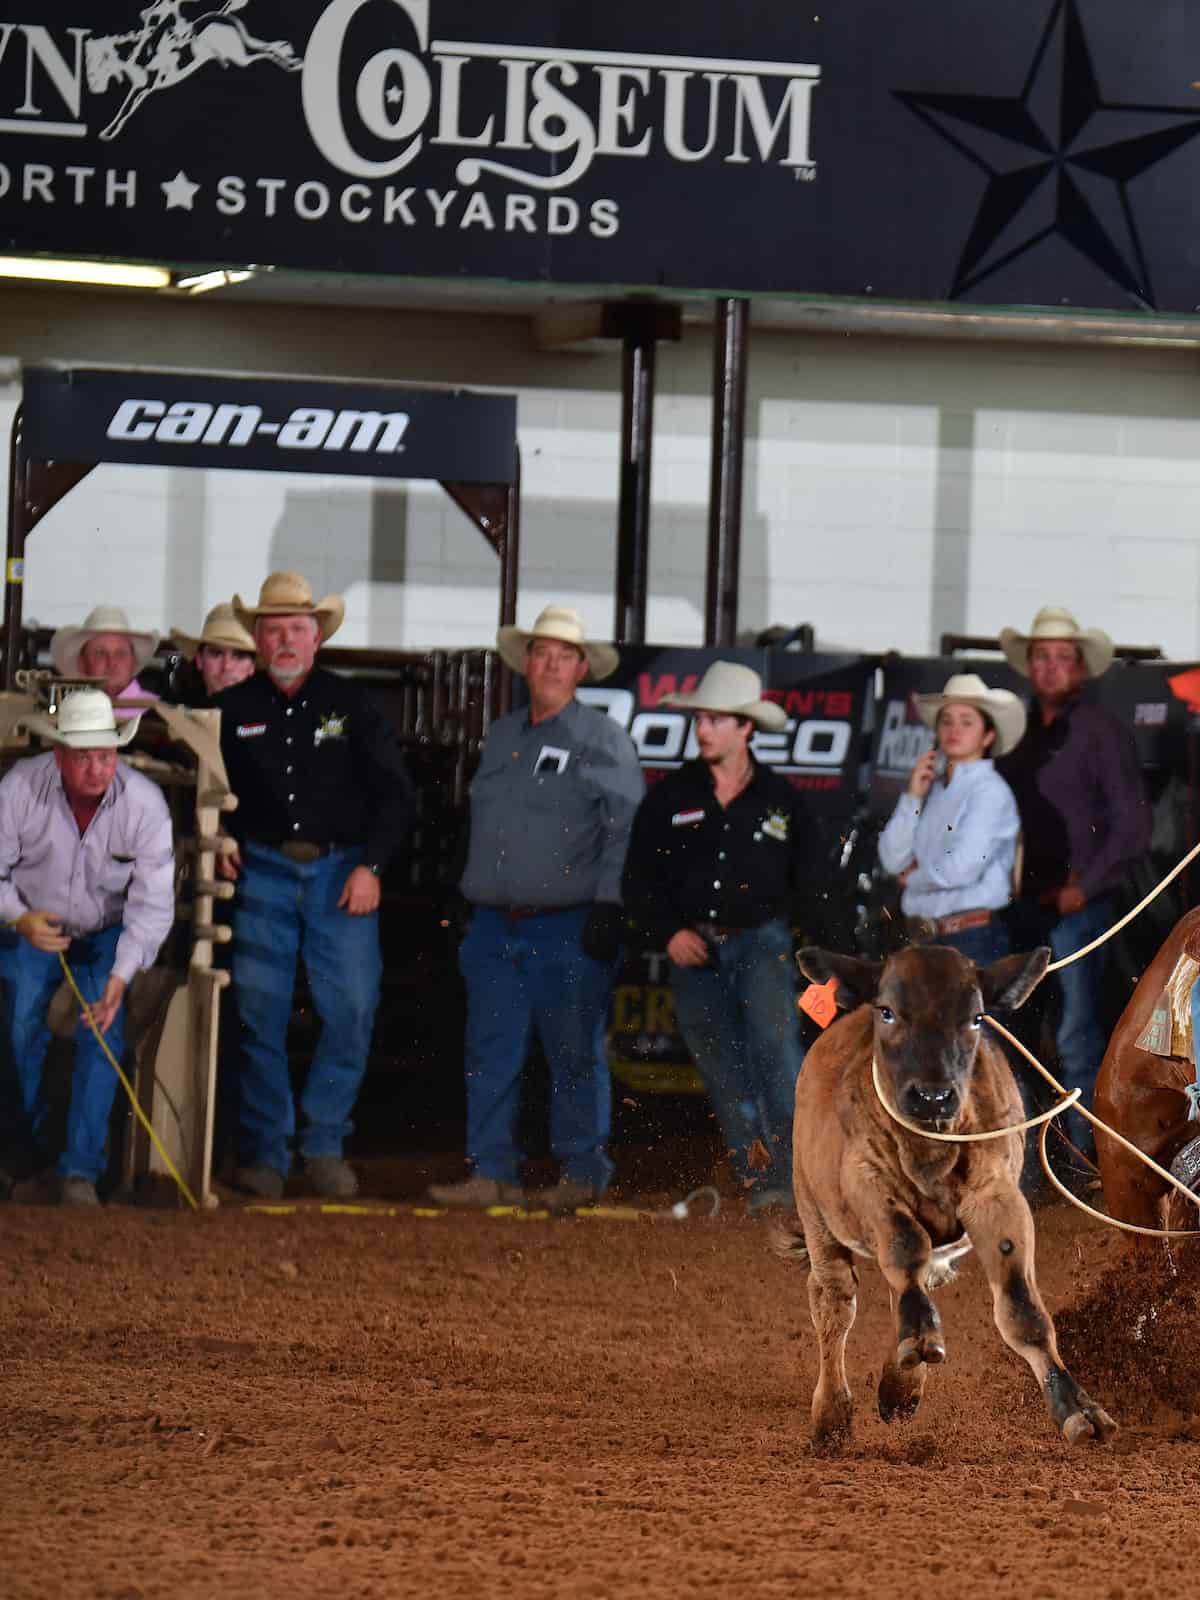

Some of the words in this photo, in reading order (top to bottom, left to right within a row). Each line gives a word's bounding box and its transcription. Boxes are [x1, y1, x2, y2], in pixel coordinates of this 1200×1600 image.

[302, 0, 821, 189] COLISEUM
[215, 176, 621, 238] STOCKYARDS
[106, 399, 409, 453] can-am
